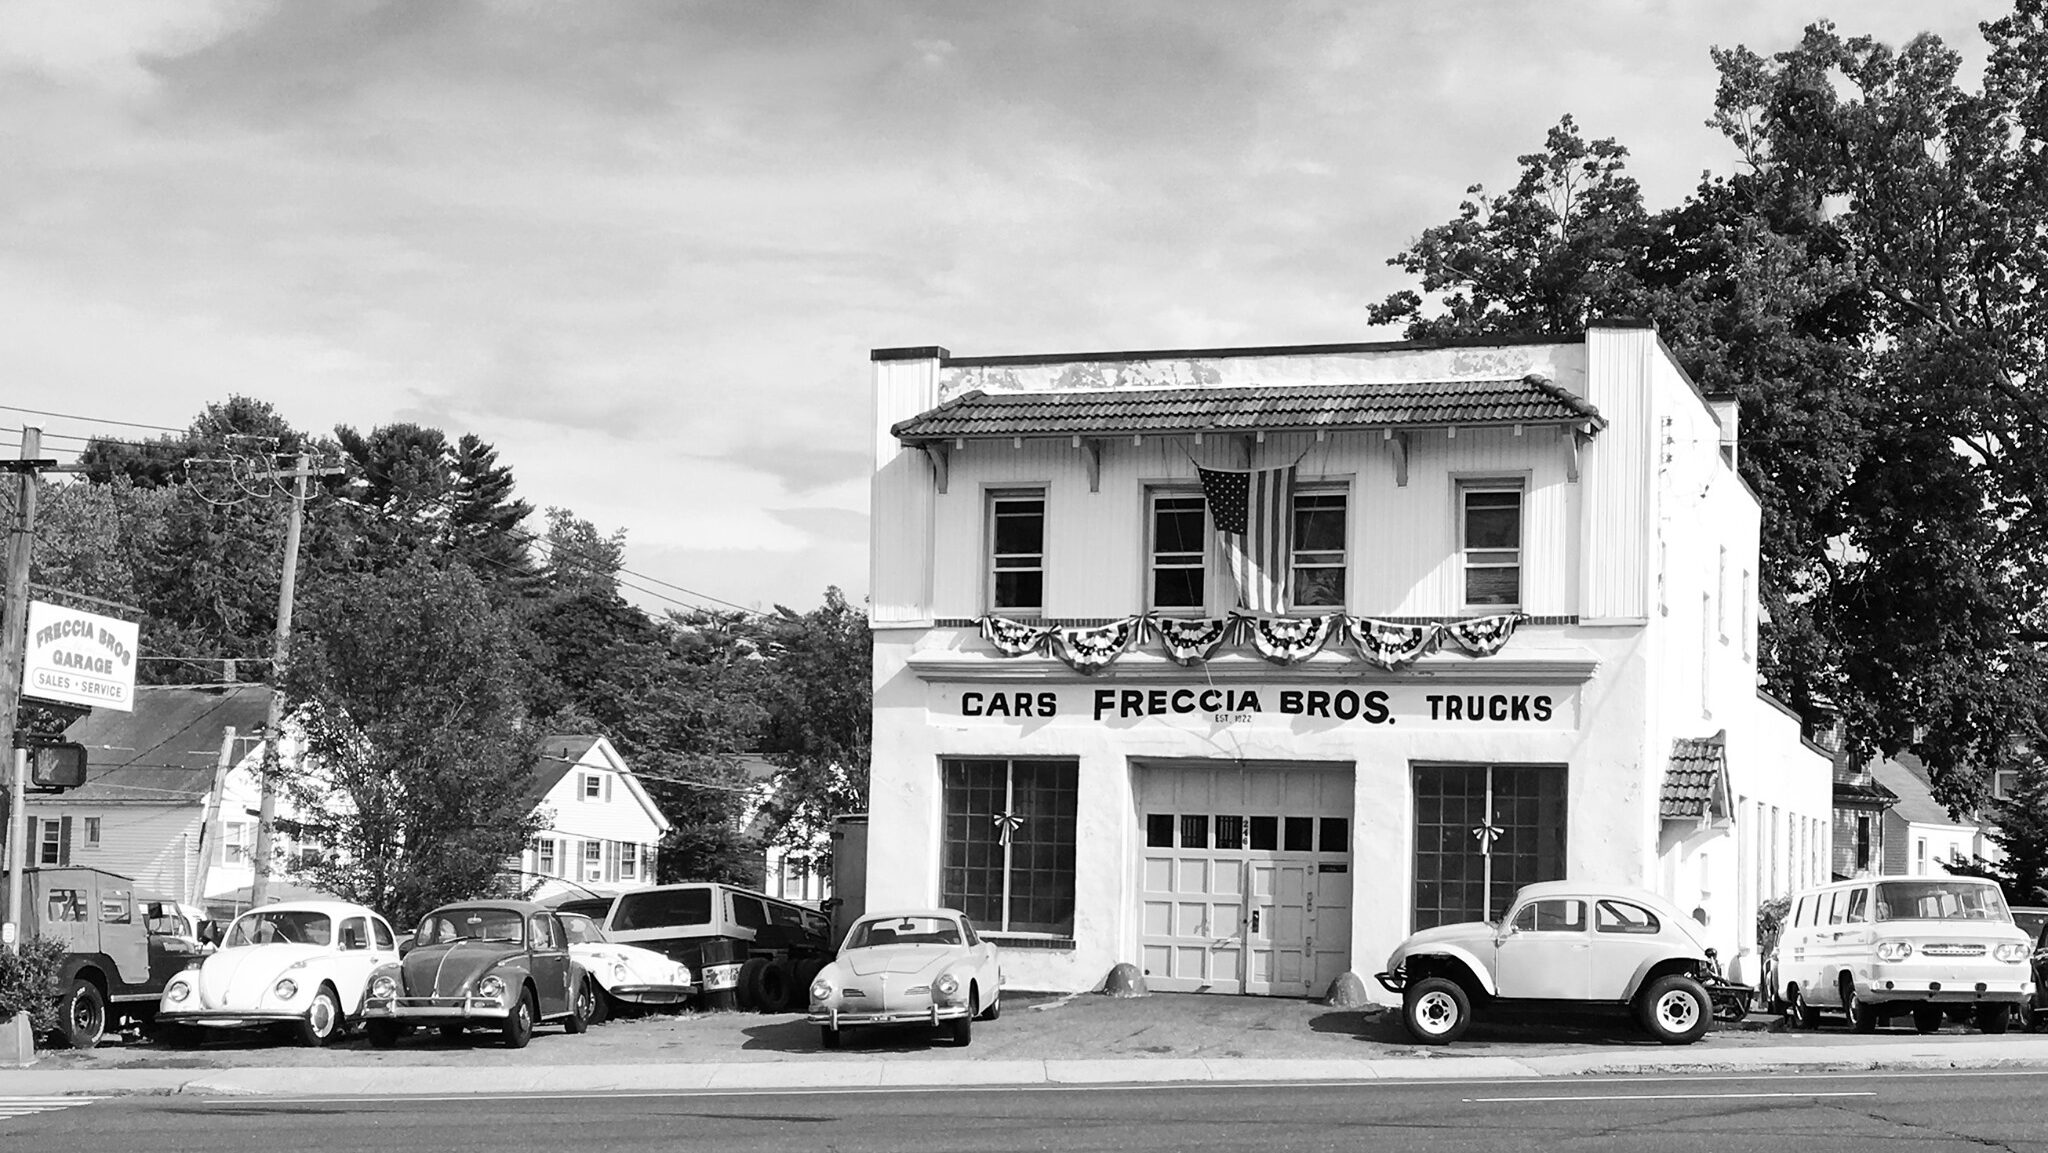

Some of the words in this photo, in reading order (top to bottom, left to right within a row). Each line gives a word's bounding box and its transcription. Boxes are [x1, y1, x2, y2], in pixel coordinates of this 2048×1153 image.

[36, 619, 94, 648] FRECCIA
[52, 649, 113, 675] GARAGE
[38, 673, 70, 689] SALES
[81, 681, 122, 698] SERVICE
[961, 692, 1056, 717] CARS
[1094, 689, 1262, 721] FRECCIA
[1279, 689, 1396, 724] BROS.
[1426, 695, 1552, 722] TRUCKS
